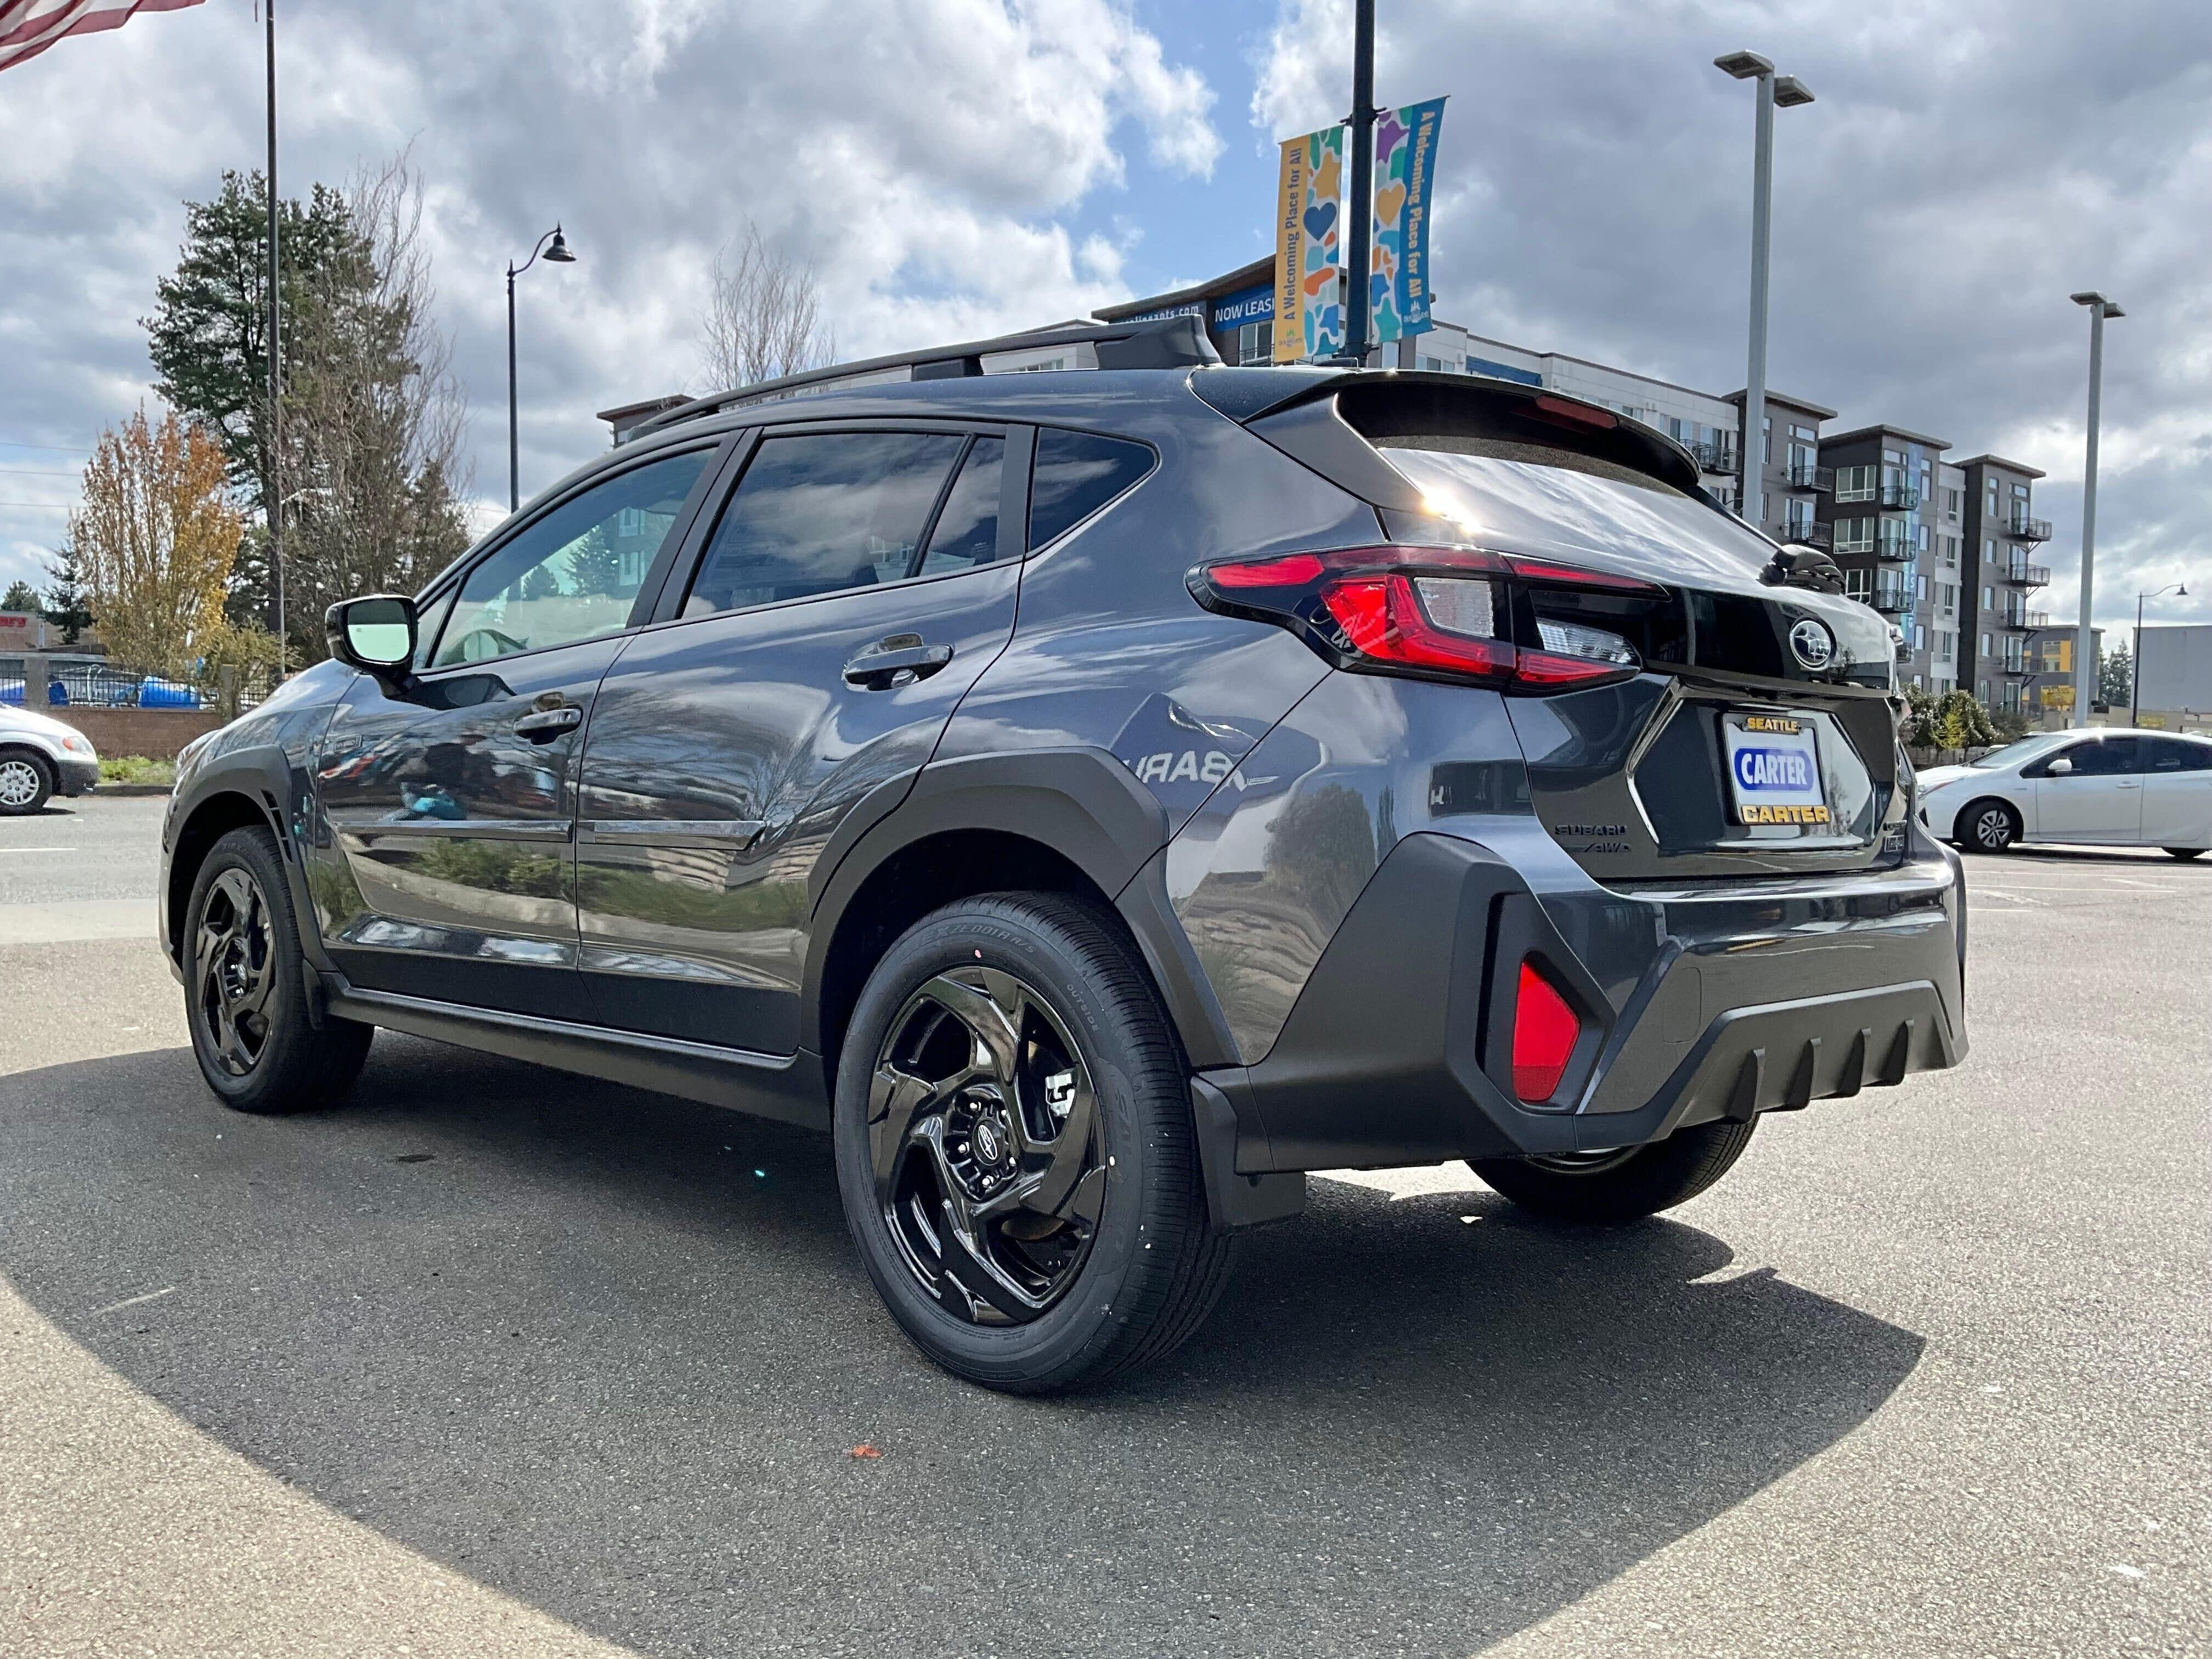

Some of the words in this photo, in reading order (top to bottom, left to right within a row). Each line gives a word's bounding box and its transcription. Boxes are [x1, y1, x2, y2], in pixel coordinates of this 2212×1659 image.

[1421, 111, 1435, 122] A
[1289, 148, 1302, 165] All
[1408, 122, 1433, 206] Welcoming
[1288, 168, 1301, 189] for
[1285, 191, 1299, 230] Place
[1408, 206, 1423, 249] Place
[1283, 231, 1300, 310] Welcoming
[1408, 252, 1421, 274] for
[1408, 278, 1423, 298] All
[1215, 304, 1243, 323] NOW
[1284, 311, 1296, 320] A
[1747, 716, 1798, 732] SEATTLE
[1741, 753, 1808, 785] CARTER
[1742, 805, 1830, 823] CARTER
[1555, 824, 1628, 836] SUBARU
[1585, 842, 1633, 853] AWD
[1066, 984, 1099, 1032] OUTSIDE
